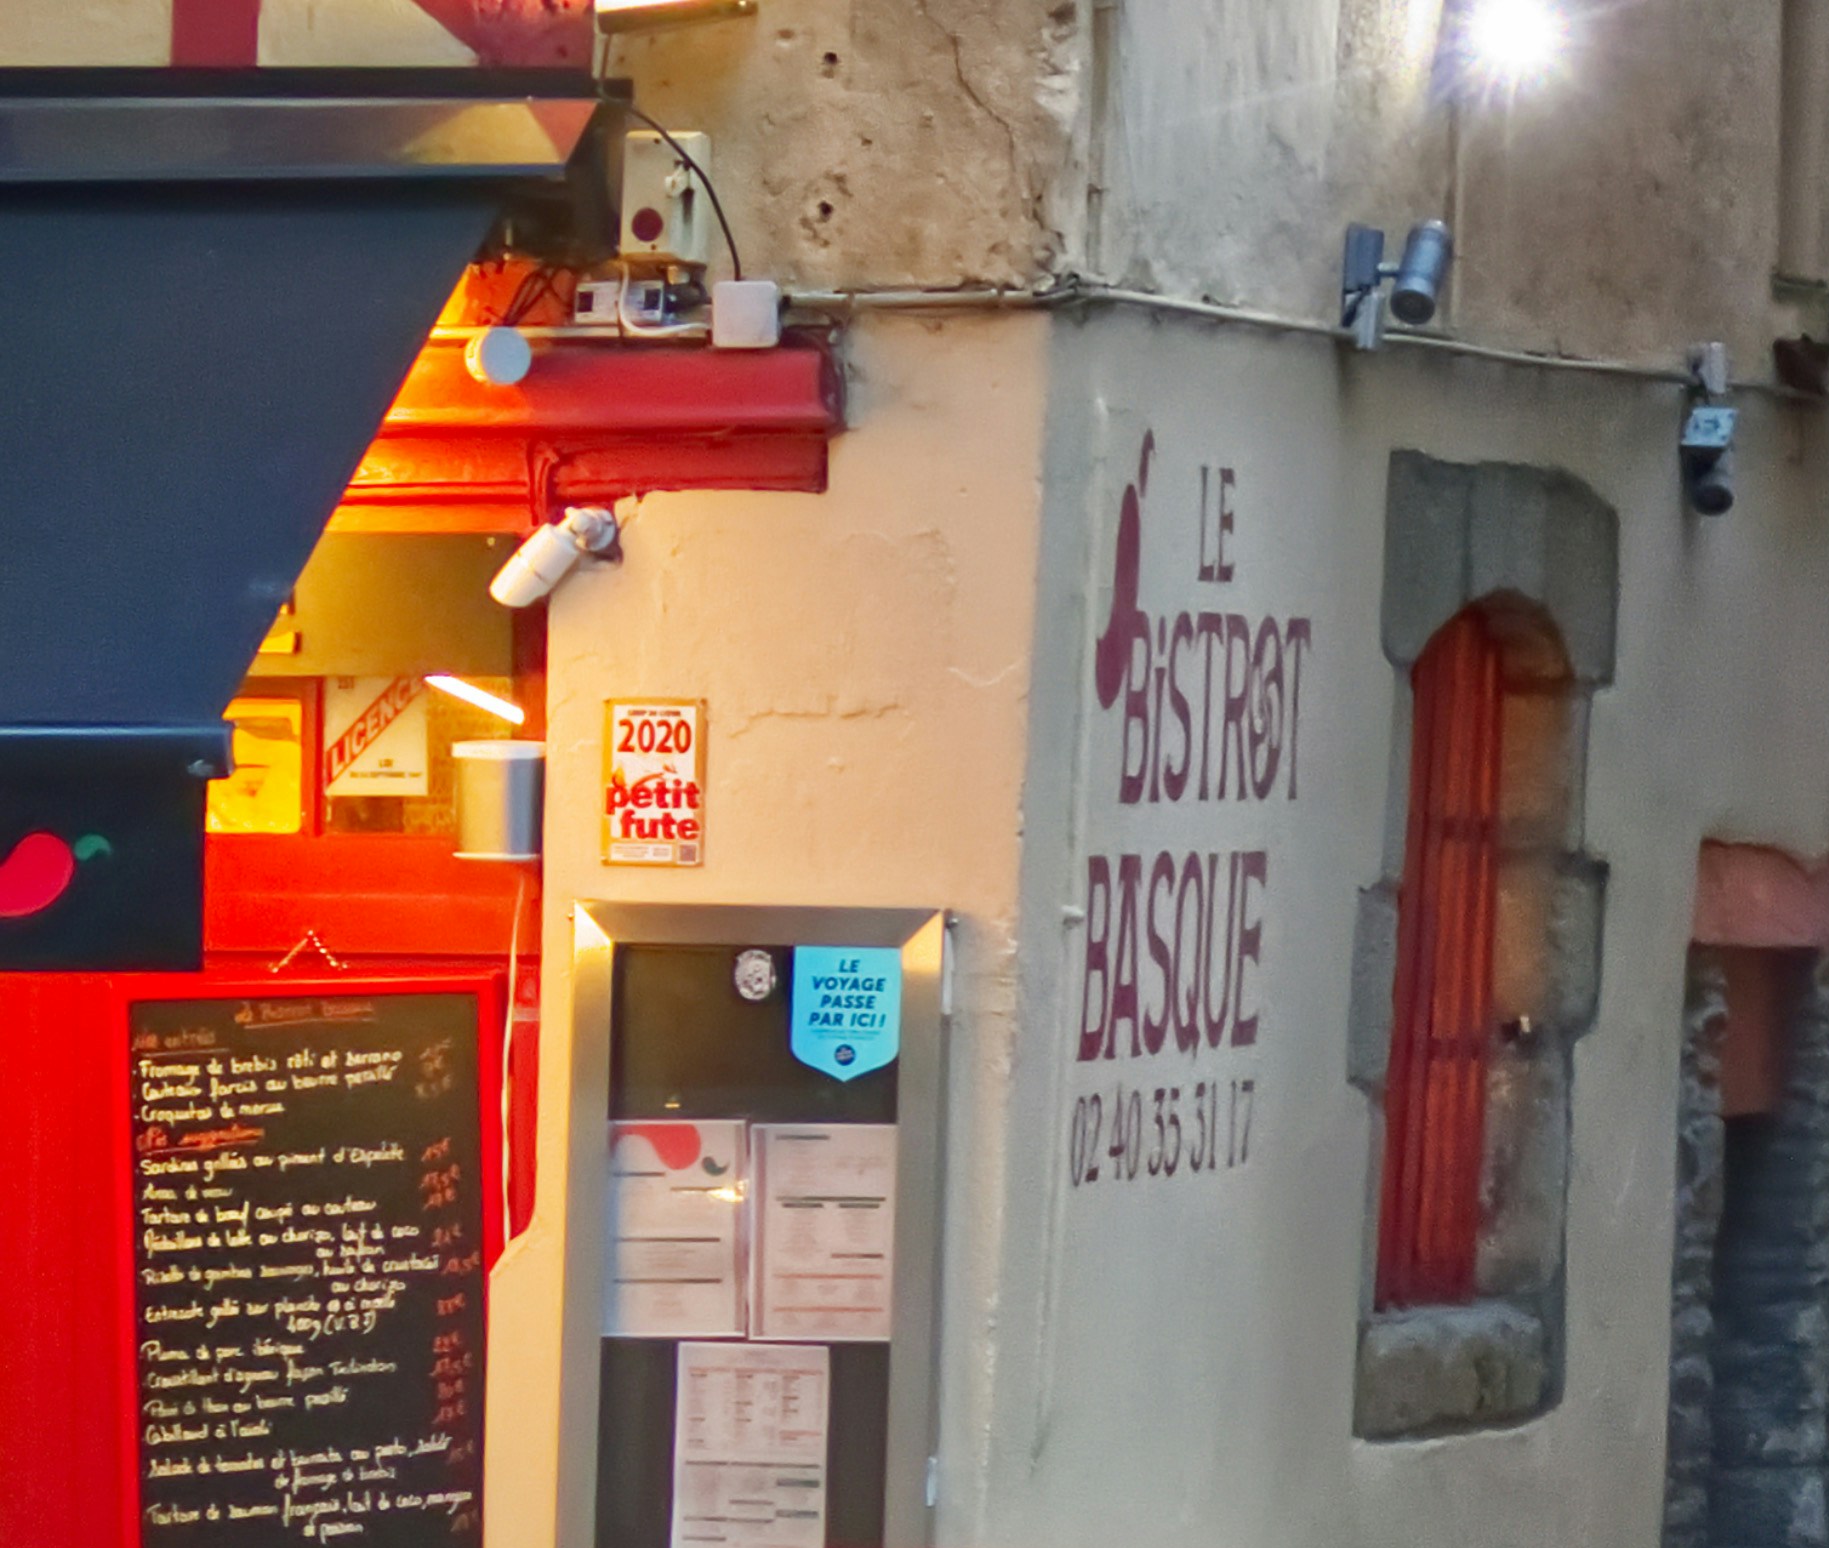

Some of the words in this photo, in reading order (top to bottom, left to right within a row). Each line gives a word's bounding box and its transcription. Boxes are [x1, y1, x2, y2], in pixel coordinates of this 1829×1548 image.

[1198, 467, 1235, 582] LE
[617, 719, 693, 753] 2020
[606, 779, 700, 815] petit
[839, 959, 860, 973] LE
[1076, 850, 1267, 1060] BASQUE
[812, 976, 886, 992] VOYAGE
[809, 1012, 844, 1026] PAR
[820, 995, 876, 1009] PASSE
[1071, 1093, 1101, 1187] 02
[1108, 1083, 1142, 1180] 40
[1148, 1087, 1181, 1176] 35
[1227, 1079, 1255, 1168] 17
